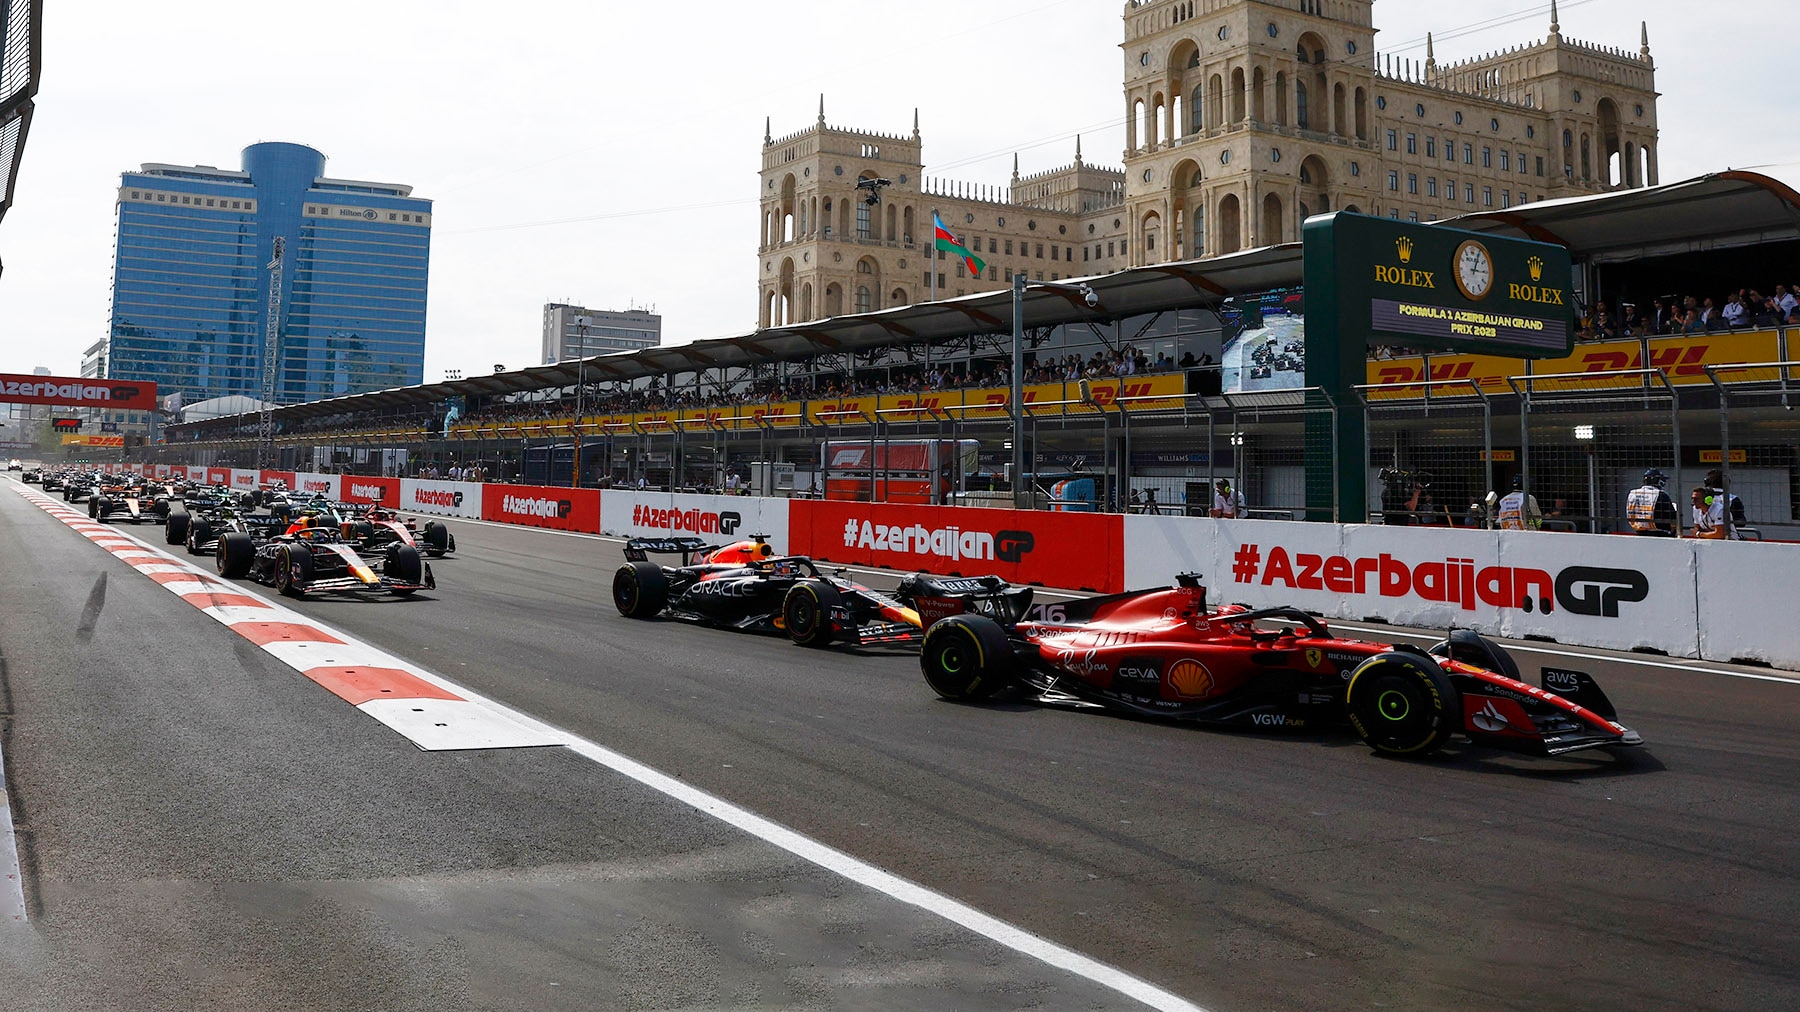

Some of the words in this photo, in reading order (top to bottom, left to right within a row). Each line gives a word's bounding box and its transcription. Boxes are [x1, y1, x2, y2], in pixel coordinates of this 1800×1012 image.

[340, 209, 361, 217] Hilton
[1374, 265, 1436, 289] ROLEX
[1508, 283, 1564, 305] ROLEX
[1399, 304, 1446, 320] FORMULA
[1447, 311, 1453, 320] 1
[1454, 311, 1512, 327] AZERBAIJAN
[1512, 317, 1543, 331] GRAND
[1451, 323, 1473, 335] PRIX
[1474, 325, 1497, 337] 2023
[1579, 346, 1710, 381] DHL
[1375, 362, 1475, 392] DHL
[1090, 384, 1154, 405] DHL
[751, 408, 785, 422] DHL
[822, 403, 861, 420] DHL
[896, 398, 941, 416] DHL
[691, 413, 722, 426] DHL
[88, 436, 124, 446] DHL
[1158, 454, 1189, 462] WILLIAMS
[415, 488, 463, 507] #AzerbaijanGP
[502, 494, 572, 518] #AzerbaijanGP
[633, 504, 741, 535] #AzerbaijanGP
[843, 518, 1035, 563] #AzerbaijanGP
[691, 581, 755, 597] ORACLE
[1232, 543, 1650, 618] #AzerbaijanGP
[925, 600, 955, 608] V-Power
[830, 611, 849, 620] Mobil
[922, 609, 945, 618] VGW
[1032, 604, 1066, 625] 16
[1039, 627, 1089, 640] Santander
[1328, 653, 1364, 661] RICHARD
[1547, 672, 1578, 685] aws
[1494, 686, 1539, 706] Santander
[1251, 714, 1286, 725] VGW
[1285, 718, 1305, 726] PLAY
